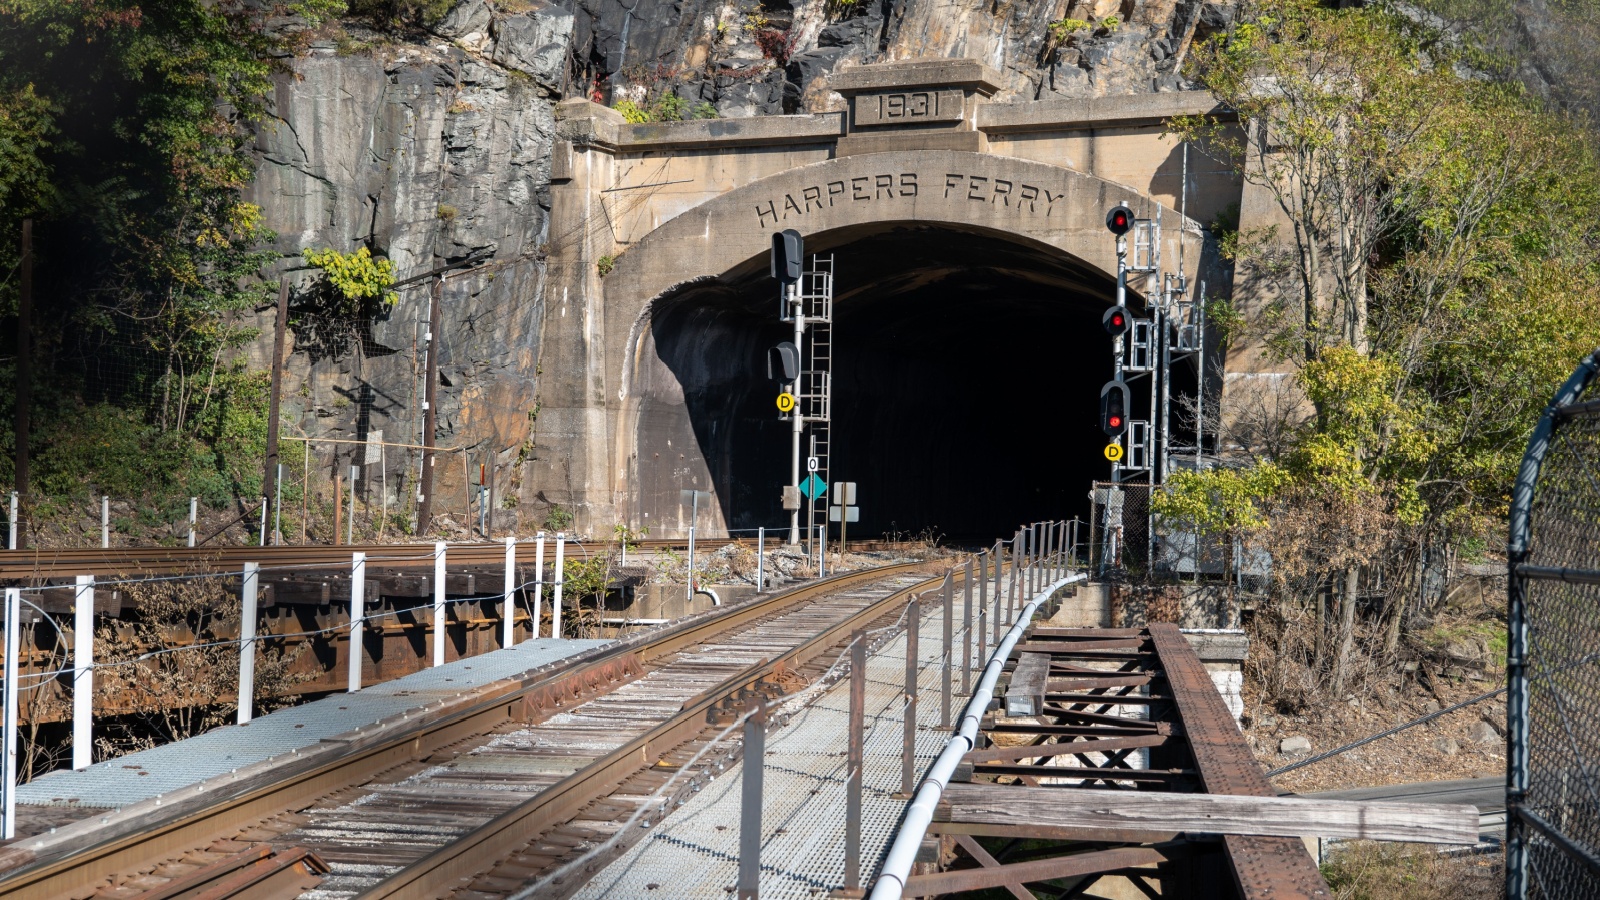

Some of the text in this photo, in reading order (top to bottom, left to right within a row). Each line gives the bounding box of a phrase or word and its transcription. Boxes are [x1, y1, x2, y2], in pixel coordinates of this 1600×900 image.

[877, 92, 939, 119] 1931
[755, 173, 1064, 228] HARPERS FERRY
[780, 396, 791, 408] D
[1108, 446, 1119, 458] D
